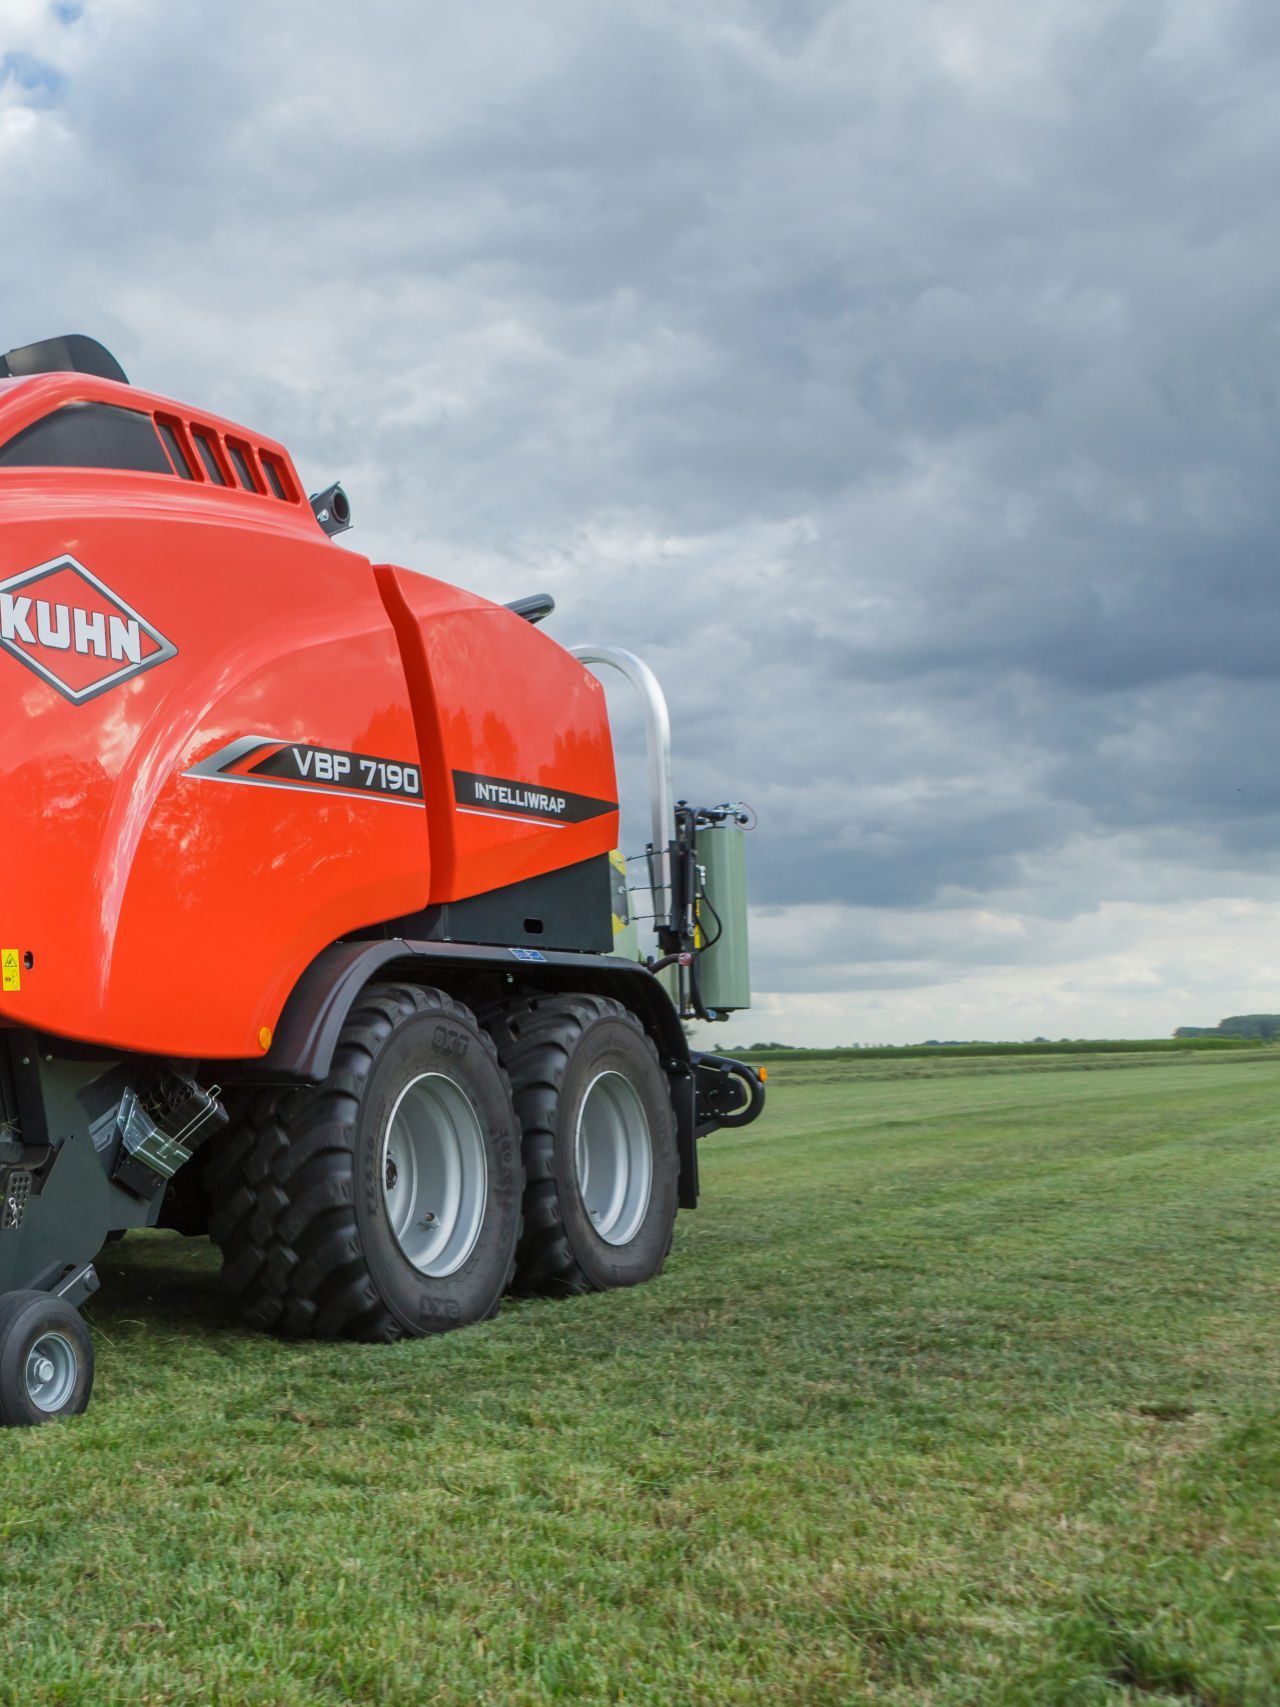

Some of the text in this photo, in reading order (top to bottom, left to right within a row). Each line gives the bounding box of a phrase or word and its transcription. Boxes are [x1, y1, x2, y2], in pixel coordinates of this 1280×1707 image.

[0, 593, 141, 664] KUHN
[292, 748, 419, 794] VBP 7190
[474, 782, 566, 814] INTELLIWRAP
[433, 1026, 469, 1057] BKT
